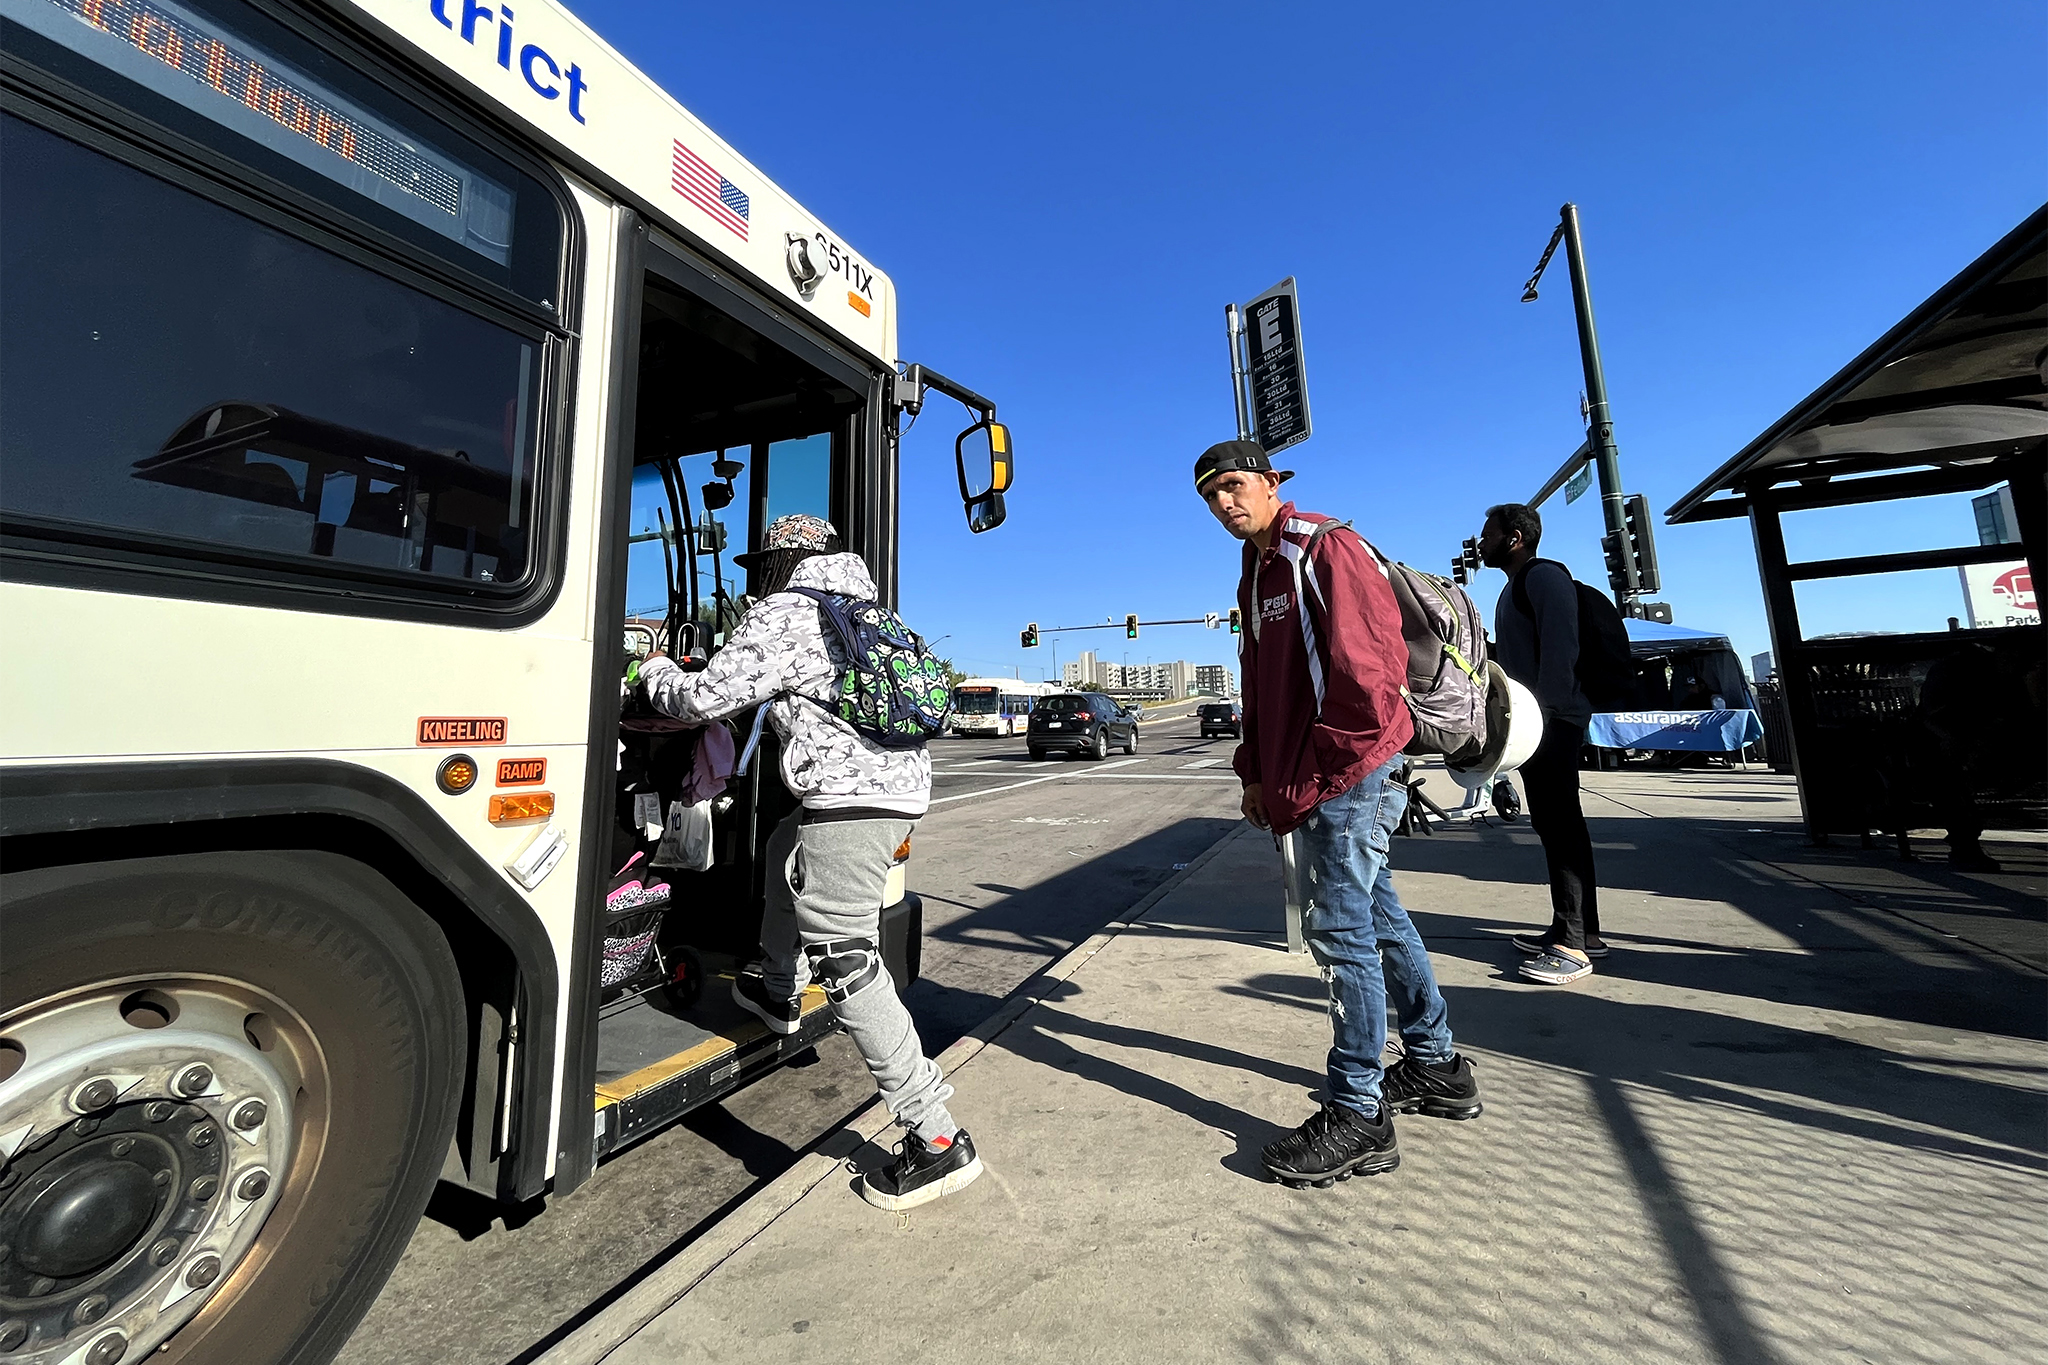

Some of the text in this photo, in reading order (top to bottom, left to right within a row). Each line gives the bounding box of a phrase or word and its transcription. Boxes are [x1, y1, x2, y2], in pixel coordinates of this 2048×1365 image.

[1256, 297, 1280, 317] GATE
[1259, 306, 1282, 354] E
[1264, 346, 1283, 361] 15Ltd
[1270, 375, 1280, 384] 30
[1266, 384, 1287, 399] 30Ltd
[1274, 400, 1282, 409] 31
[423, 722, 502, 741] KNEELING
[500, 763, 543, 780] RAMP
